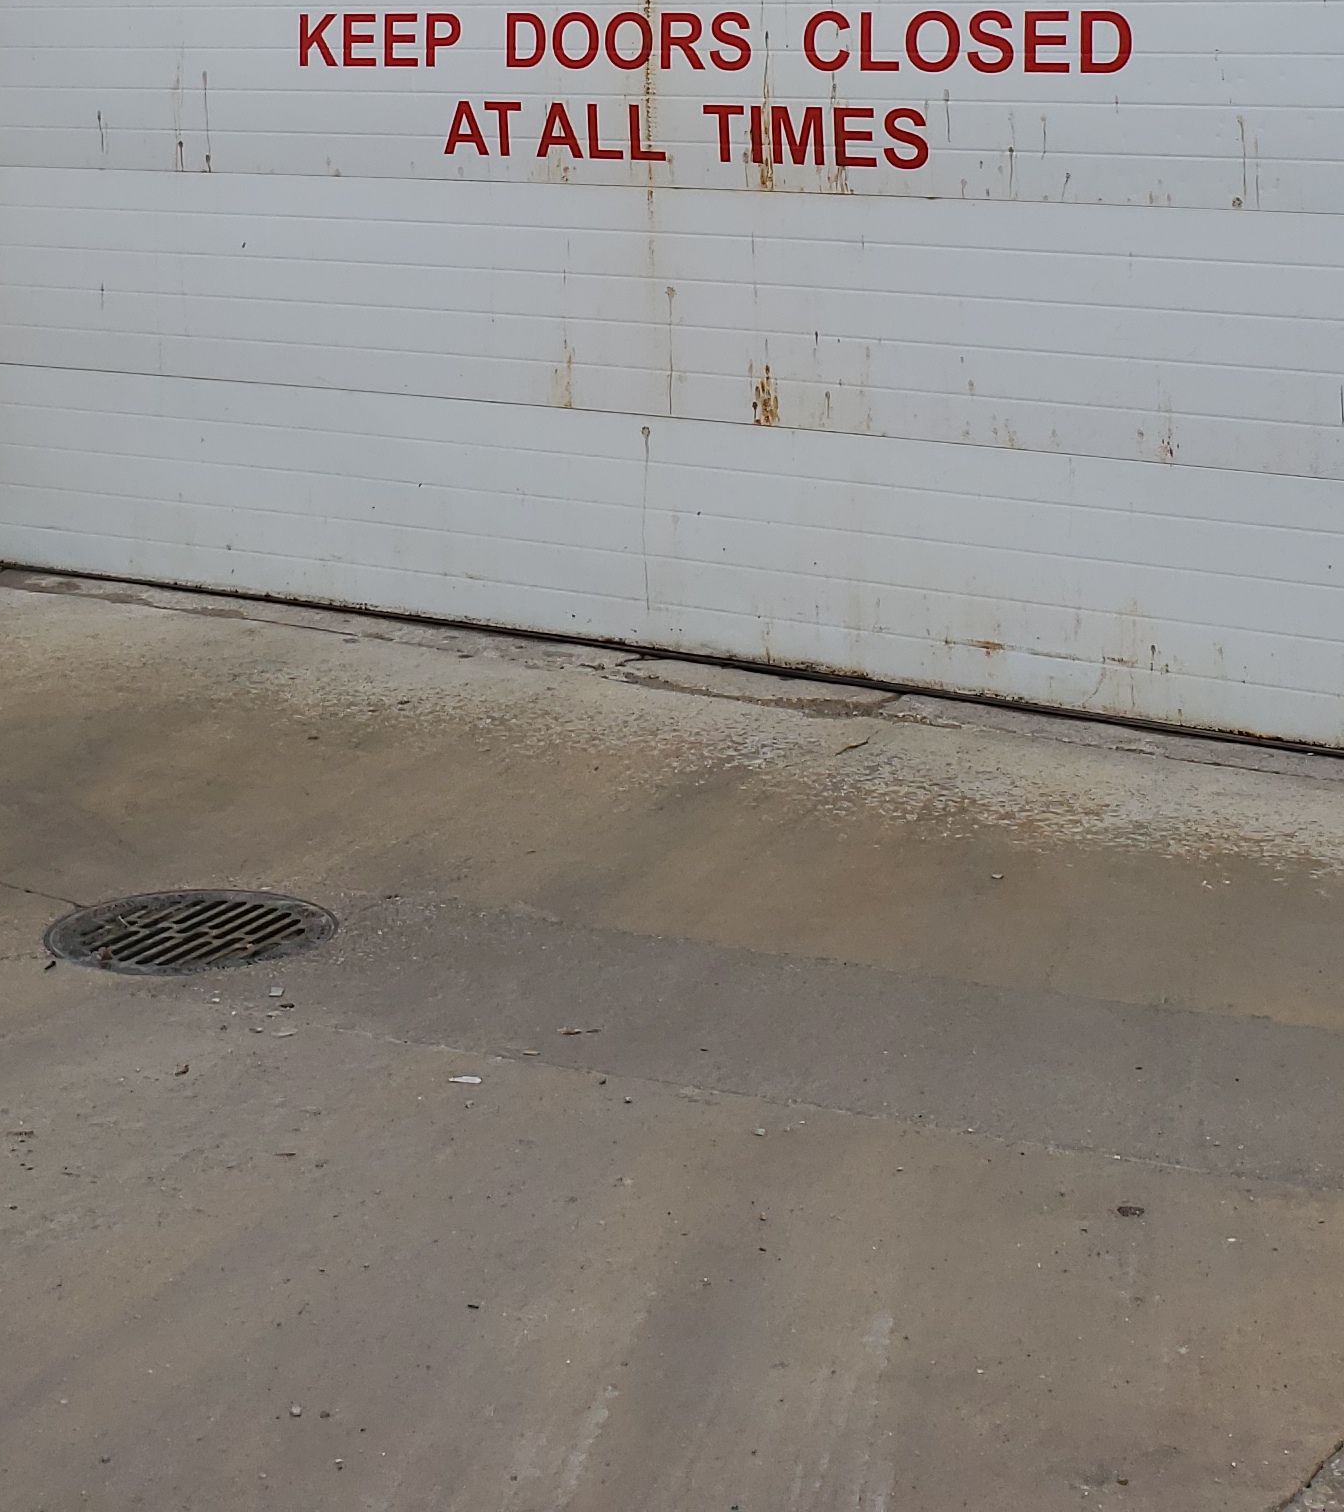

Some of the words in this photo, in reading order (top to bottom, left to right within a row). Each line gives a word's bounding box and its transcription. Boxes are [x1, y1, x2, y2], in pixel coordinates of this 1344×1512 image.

[299, 12, 462, 68] KEEP
[505, 10, 753, 71] DOORS
[803, 9, 1133, 74] CLOSED
[444, 100, 521, 156] AT
[536, 102, 667, 162] ALL
[703, 104, 930, 170] TIMES
